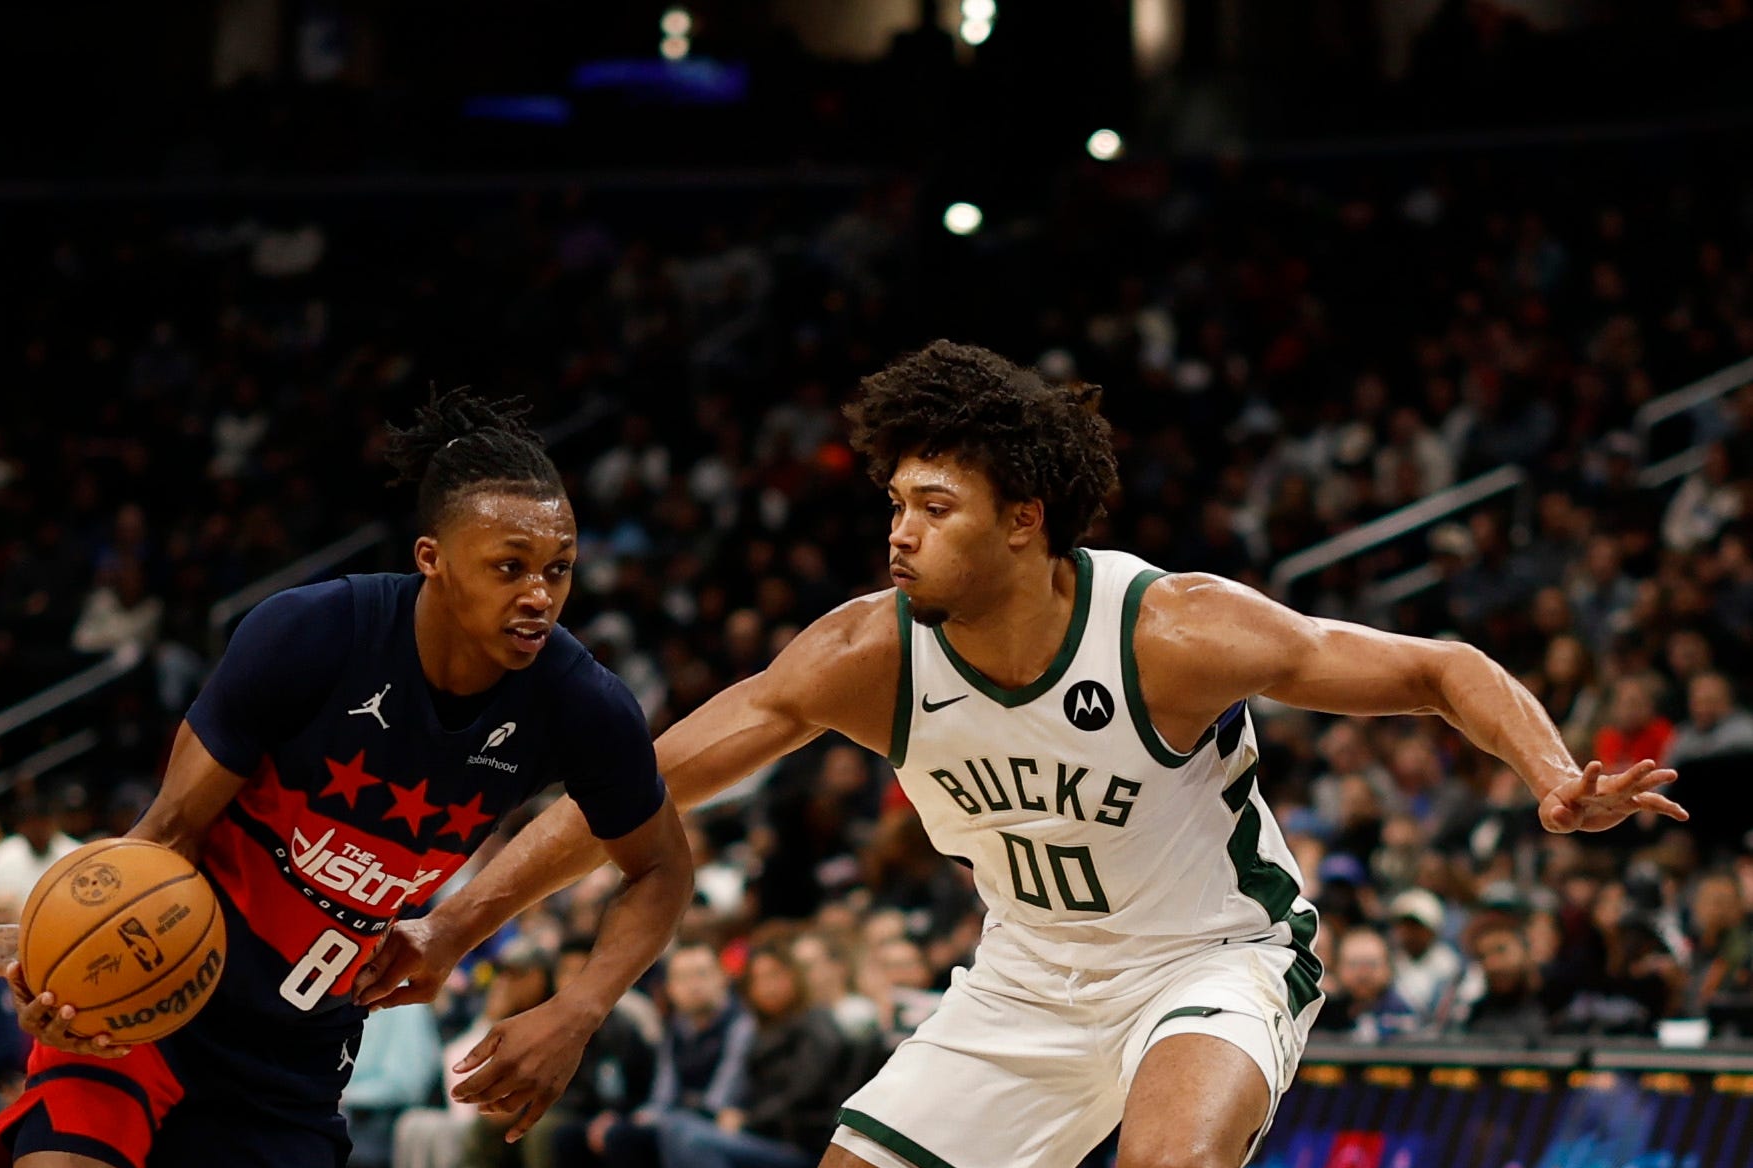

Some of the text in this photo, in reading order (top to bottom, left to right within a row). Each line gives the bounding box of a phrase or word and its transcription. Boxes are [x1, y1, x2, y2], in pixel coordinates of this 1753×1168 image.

[929, 757, 1142, 828] BUCKS
[342, 843, 377, 866] THE
[998, 831, 1110, 913] 00
[103, 948, 222, 1031] Wilson
[279, 929, 359, 1011] 8
